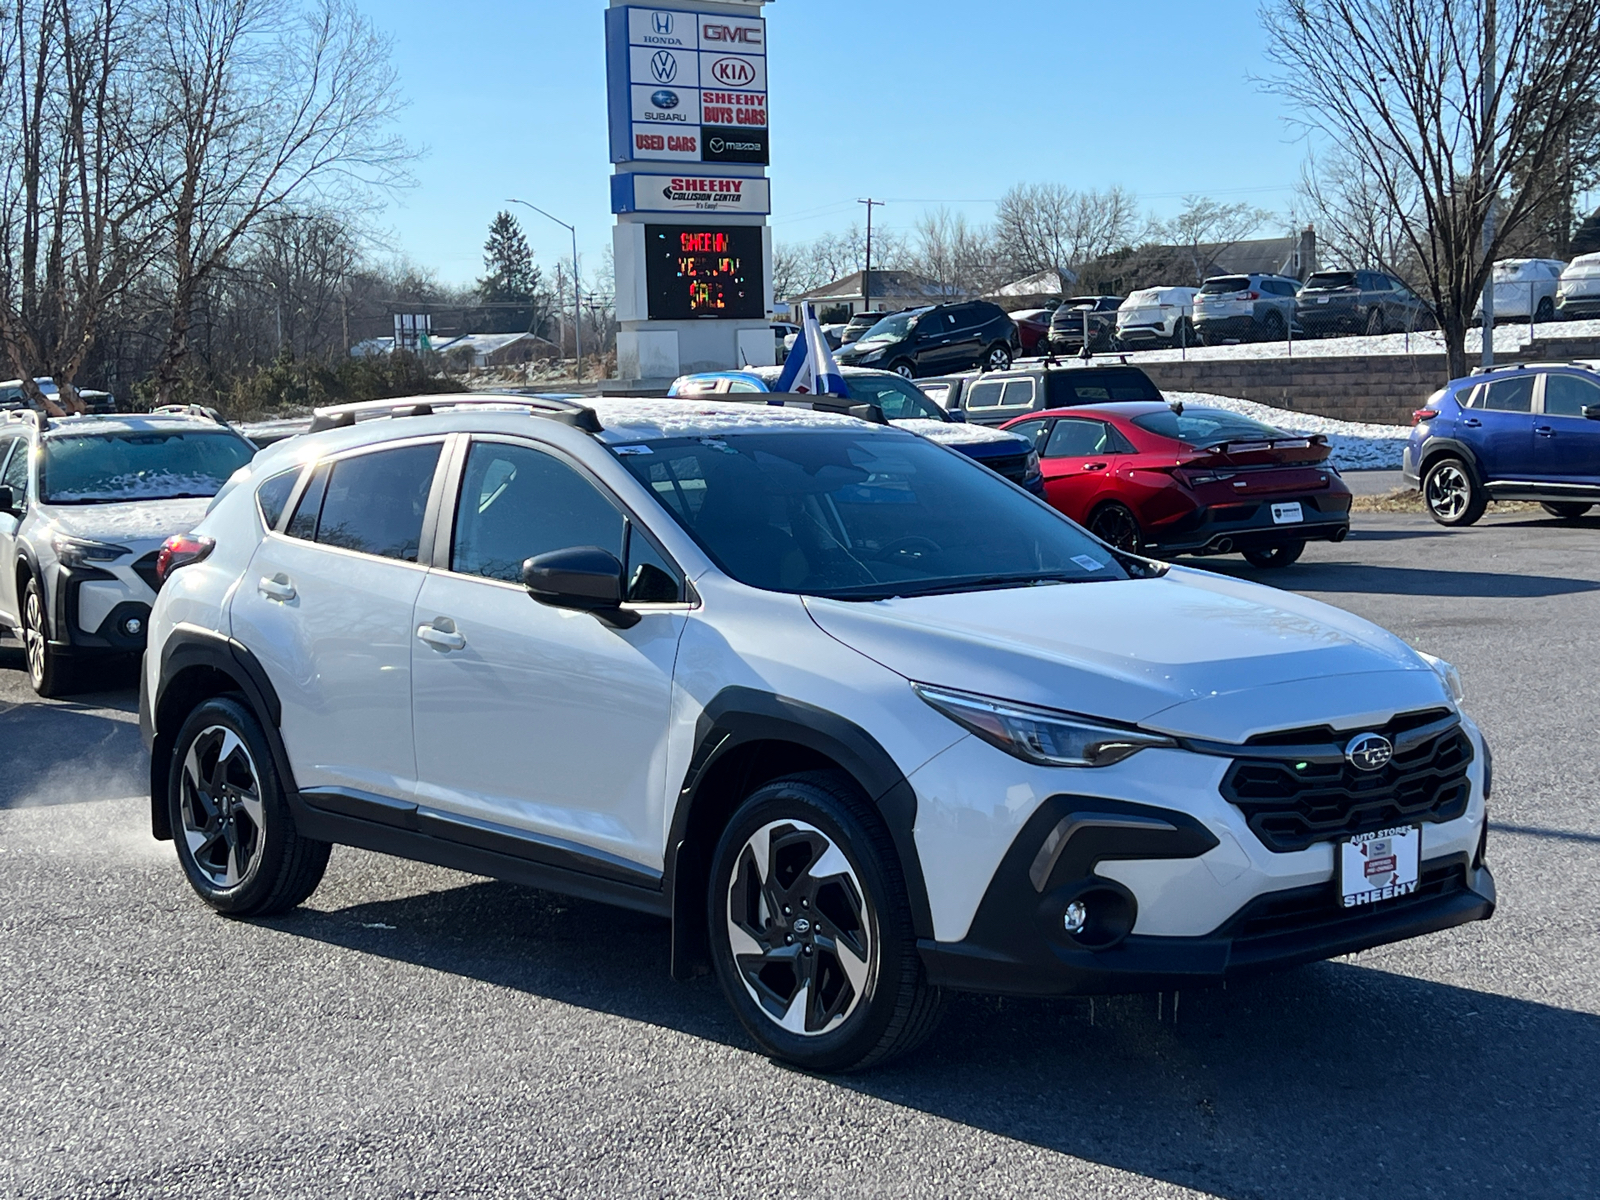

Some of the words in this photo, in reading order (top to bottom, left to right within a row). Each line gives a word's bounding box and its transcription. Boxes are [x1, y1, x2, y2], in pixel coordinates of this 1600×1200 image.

[643, 36, 682, 45] HONDA
[703, 24, 761, 45] GMC
[719, 63, 748, 80] KIA
[703, 92, 765, 106] SHEEHY
[644, 112, 686, 121] SUBARU
[704, 106, 733, 124] BUYS
[736, 109, 765, 125] CARS
[635, 134, 664, 150] USED
[668, 136, 696, 152] CARS
[726, 142, 761, 151] mazda
[671, 178, 743, 192] SHEEHY
[672, 192, 712, 201] COLLISION
[713, 193, 742, 202] CENTER
[1350, 832, 1375, 844] AUTO
[1377, 825, 1412, 837] STORES
[1344, 880, 1418, 907] SHEEHY
